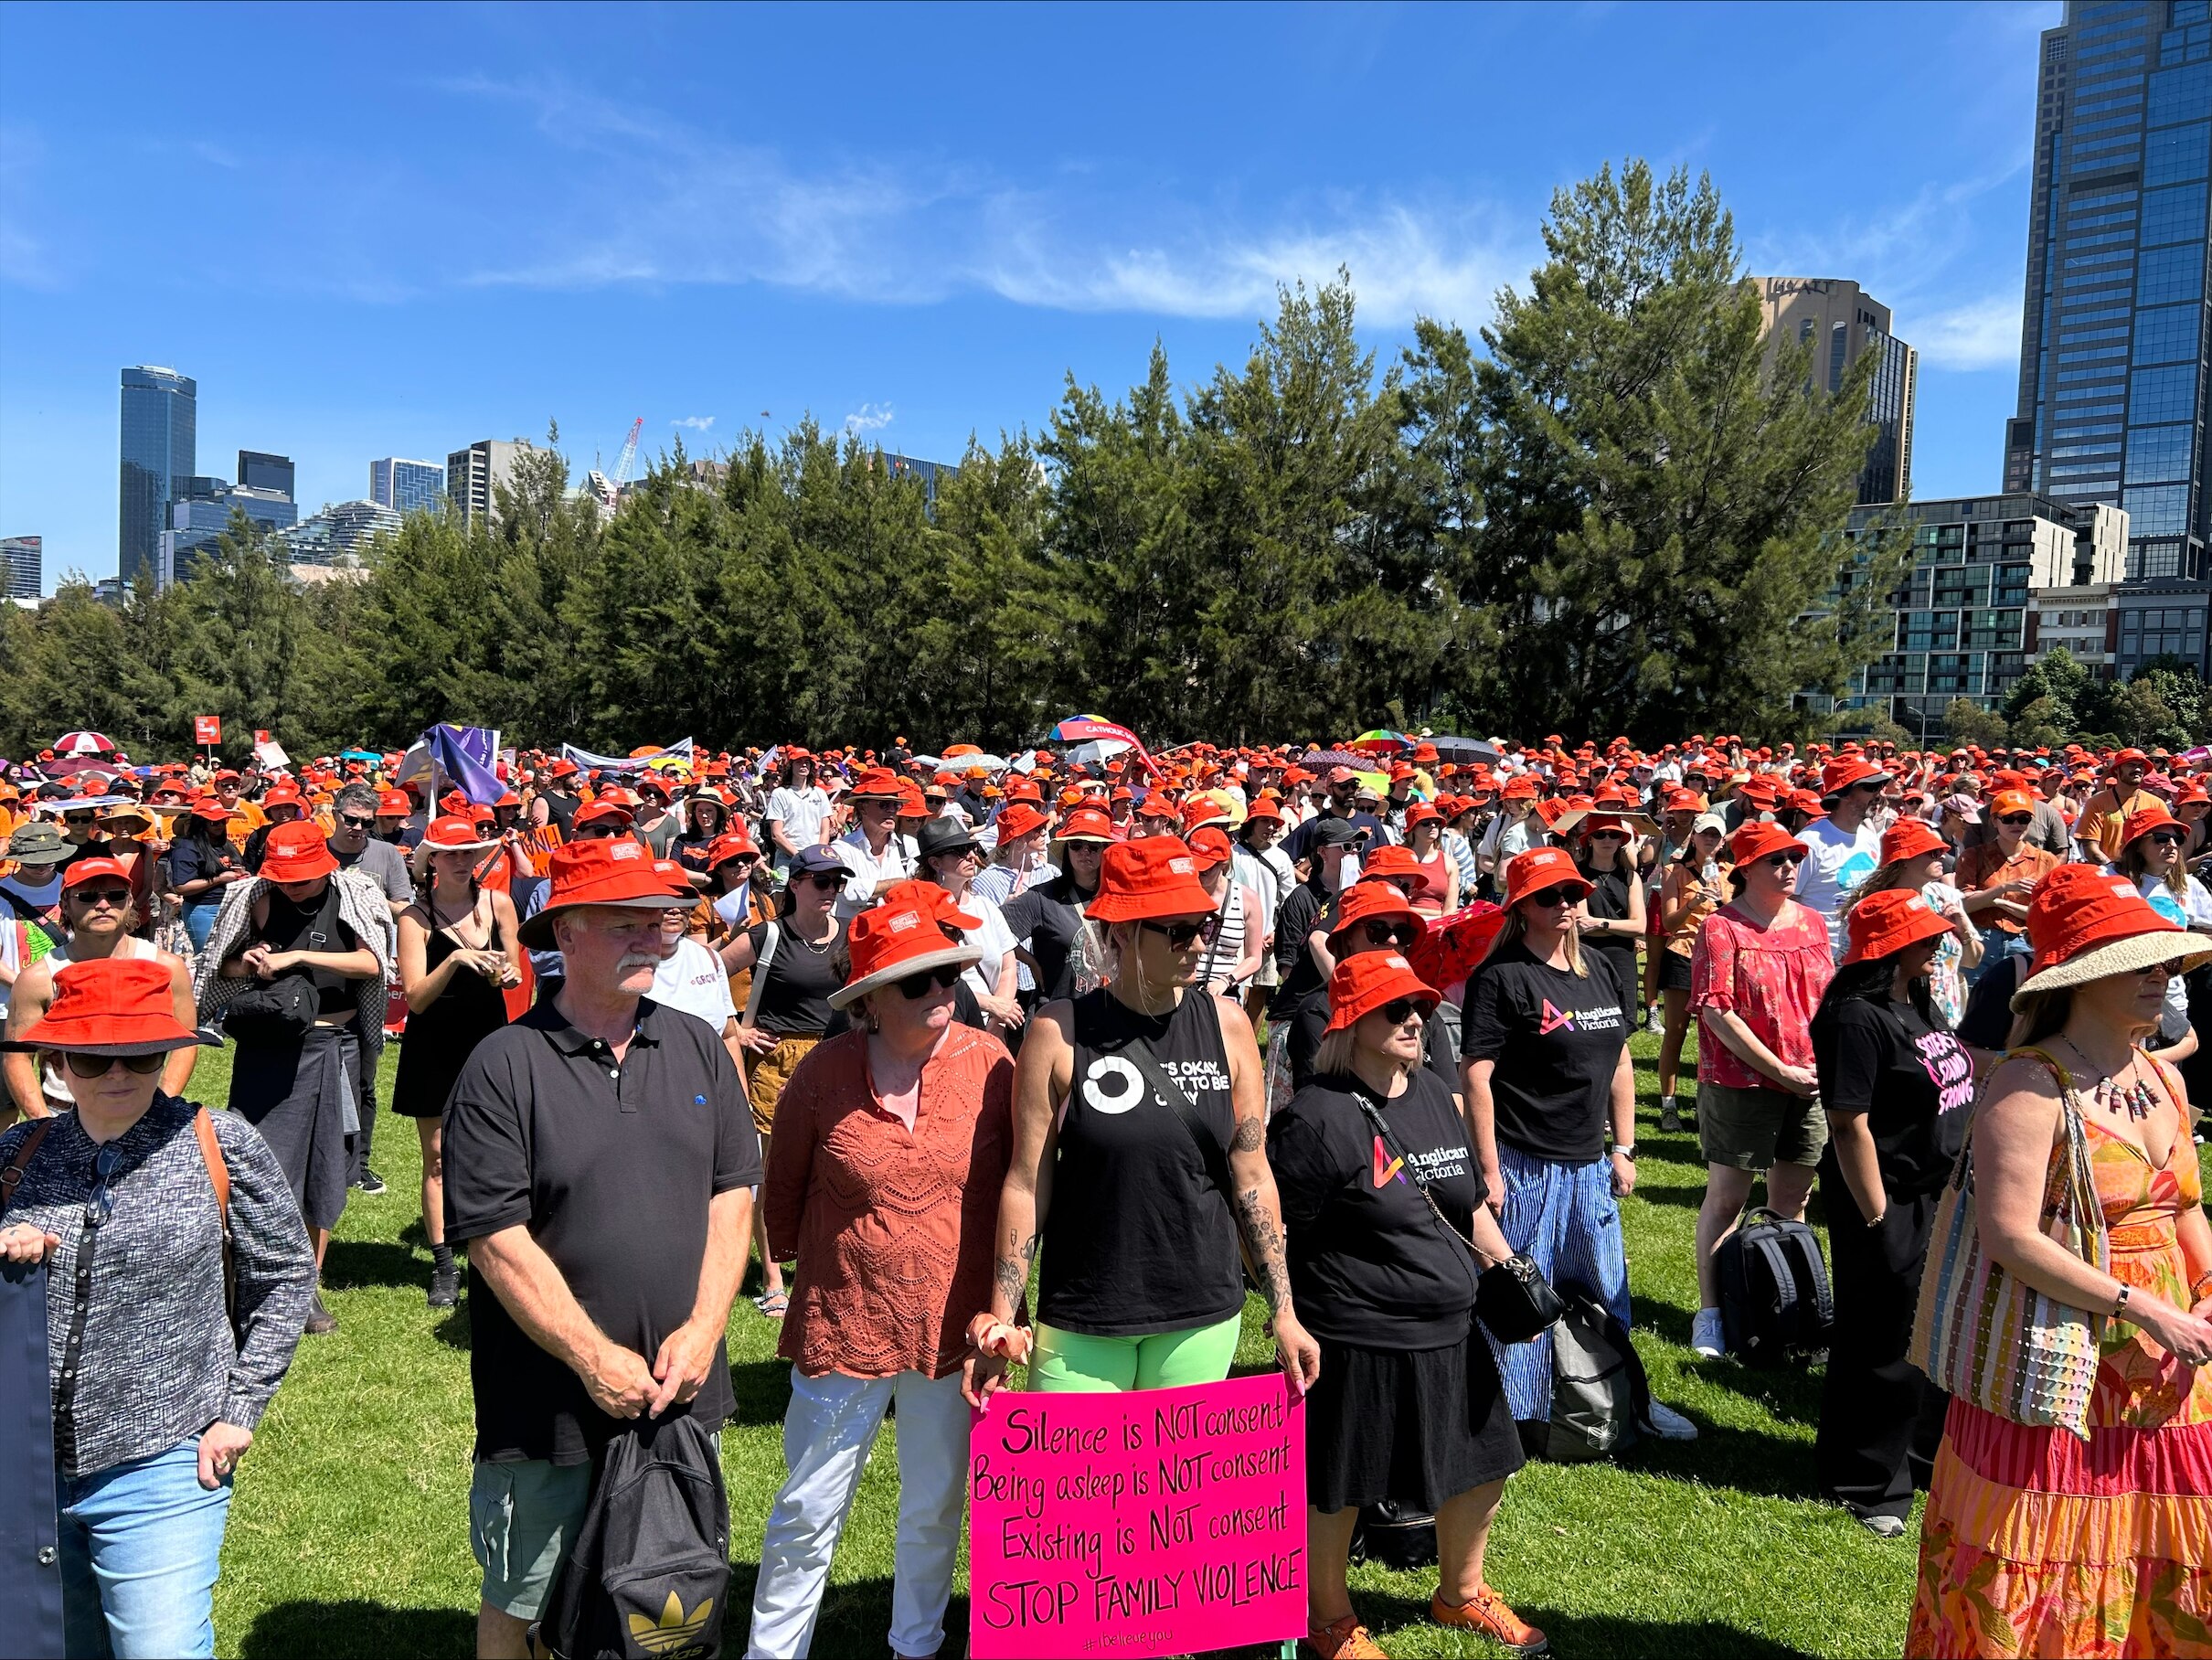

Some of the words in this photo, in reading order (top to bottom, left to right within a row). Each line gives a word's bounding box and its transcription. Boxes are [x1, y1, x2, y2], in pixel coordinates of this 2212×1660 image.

[1574, 1006, 1622, 1021] Anglican
[1578, 1017, 1620, 1031] Victoria
[1181, 1060, 1220, 1077] OKAY,
[1188, 1075, 1210, 1091] TO
[1211, 1075, 1230, 1091] BE
[1415, 1164, 1464, 1182] ictoria
[1001, 1409, 1108, 1454] Silence
[1122, 1414, 1142, 1451] is
[1154, 1399, 1207, 1447] NOT
[1205, 1391, 1283, 1434] consent
[973, 1453, 1045, 1519] Being
[1056, 1464, 1125, 1510] asleep
[1133, 1463, 1149, 1495] is
[1158, 1451, 1213, 1496] NOT
[1210, 1435, 1292, 1483] consent
[1002, 1516, 1101, 1580] Existing
[1115, 1518, 1135, 1555] is
[1150, 1504, 1201, 1551] NOT
[1208, 1490, 1291, 1539] consent
[983, 1580, 1079, 1629] STOP
[1094, 1569, 1186, 1622] FAMILY
[1192, 1548, 1303, 1607] VIOLENCE
